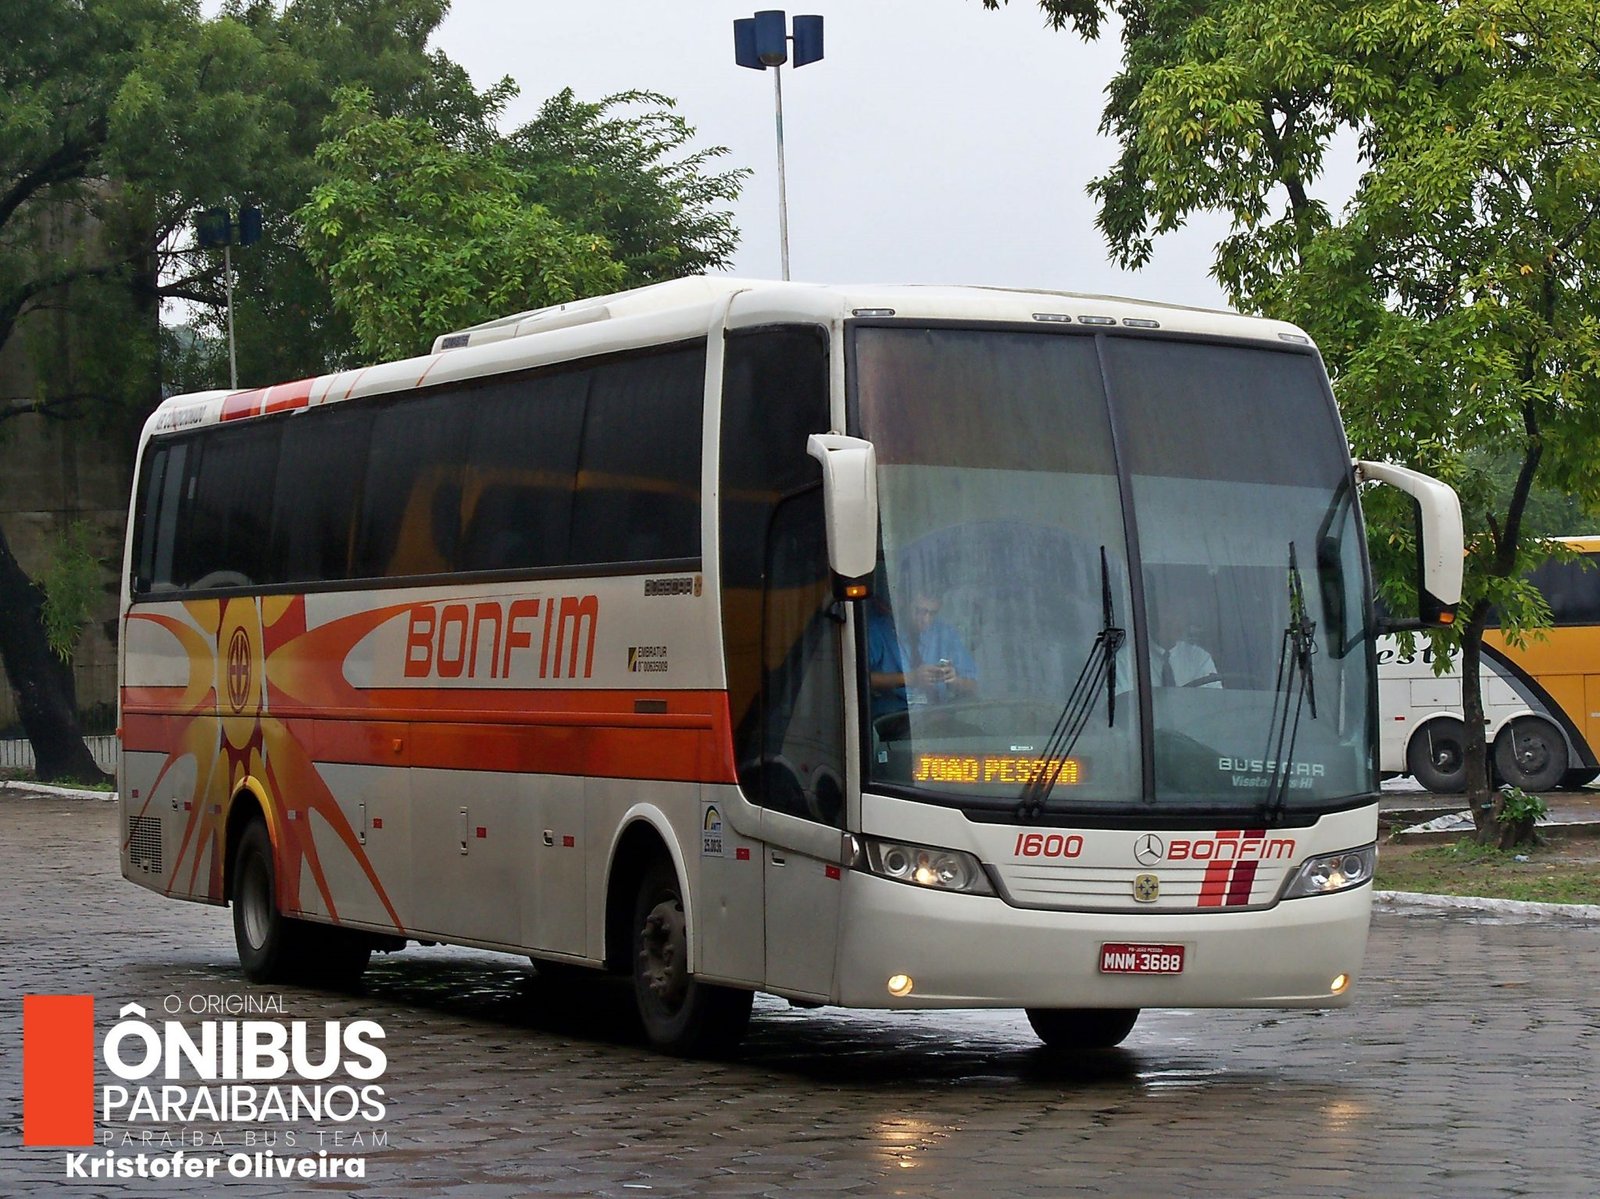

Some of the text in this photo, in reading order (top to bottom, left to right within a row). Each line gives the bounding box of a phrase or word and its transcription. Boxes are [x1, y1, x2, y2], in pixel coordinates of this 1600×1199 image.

[404, 594, 599, 679] BONFIM
[1014, 833, 1082, 858] 1600
[1168, 839, 1295, 860] BONFIM
